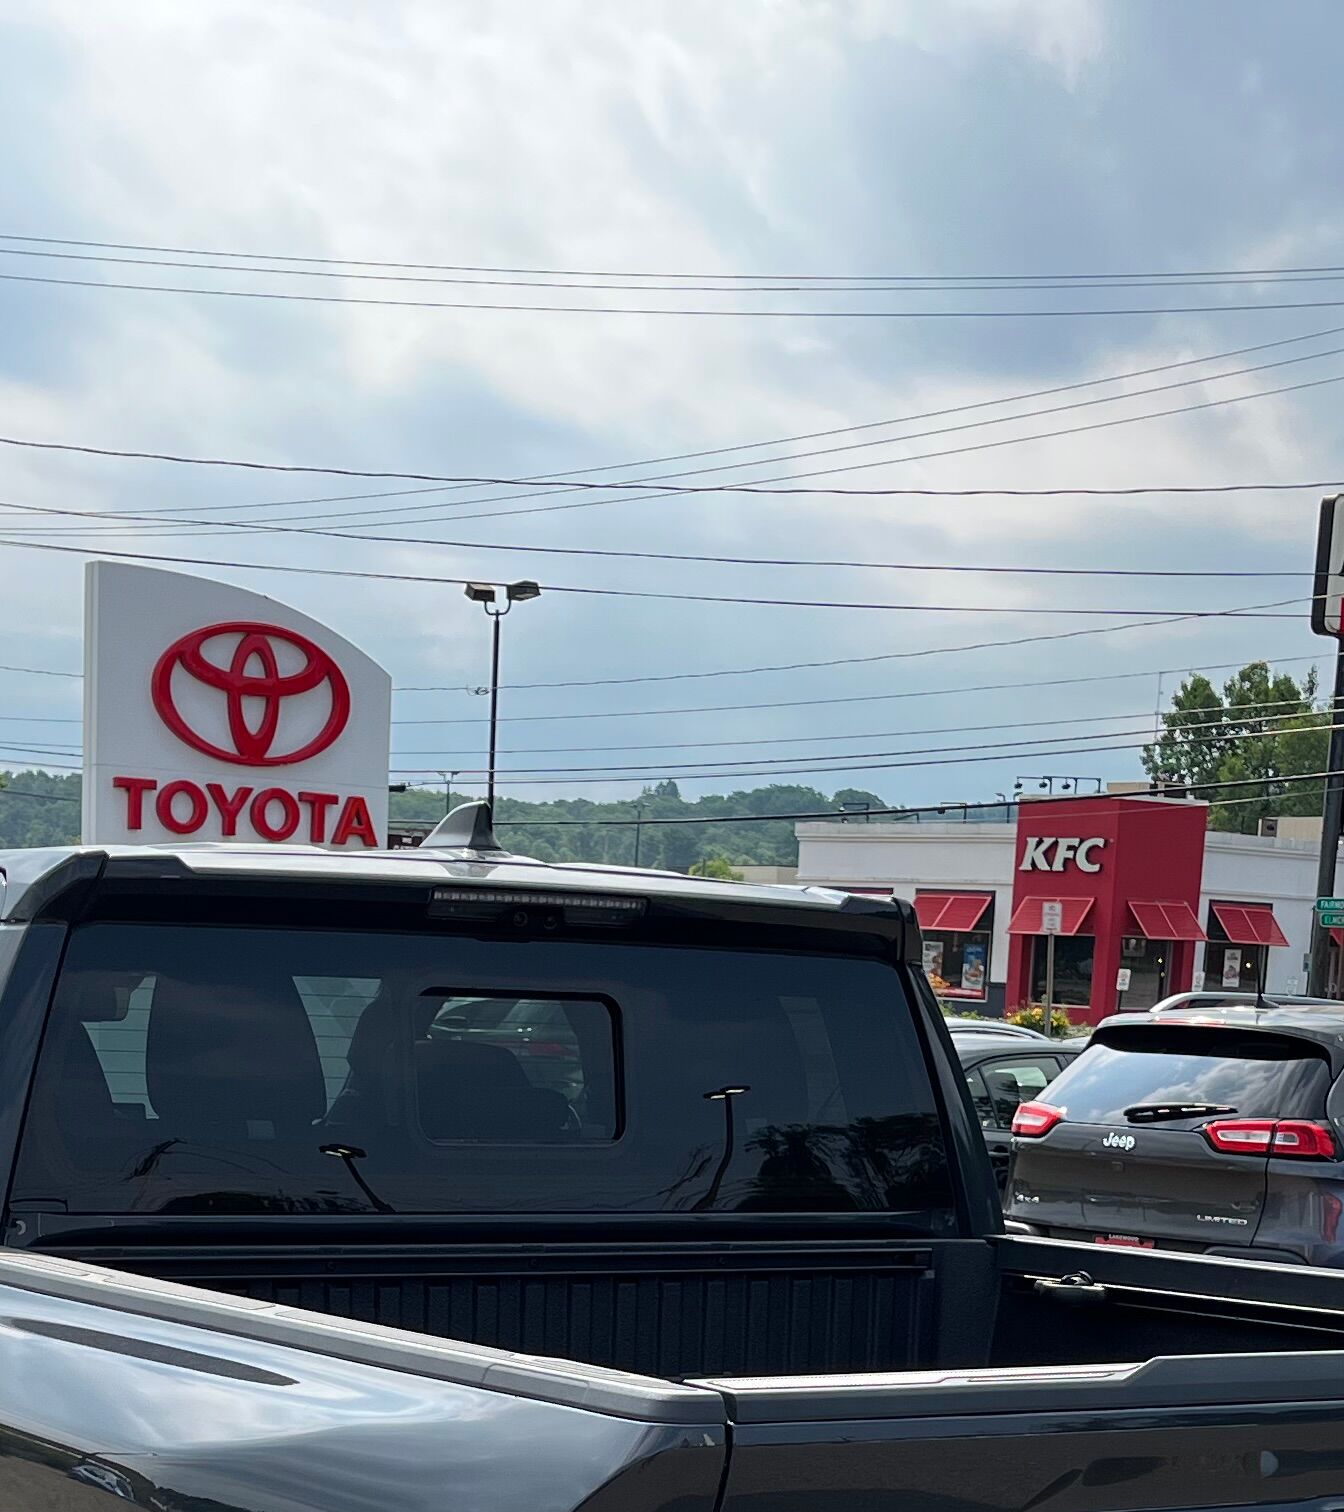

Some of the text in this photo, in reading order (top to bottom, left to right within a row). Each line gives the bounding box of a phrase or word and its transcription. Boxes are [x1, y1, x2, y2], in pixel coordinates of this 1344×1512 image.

[113, 777, 378, 847] TOYOTA
[1019, 837, 1105, 873] KFC
[1102, 1132, 1136, 1151] Jeep
[1196, 1214, 1248, 1226] LIMITED
